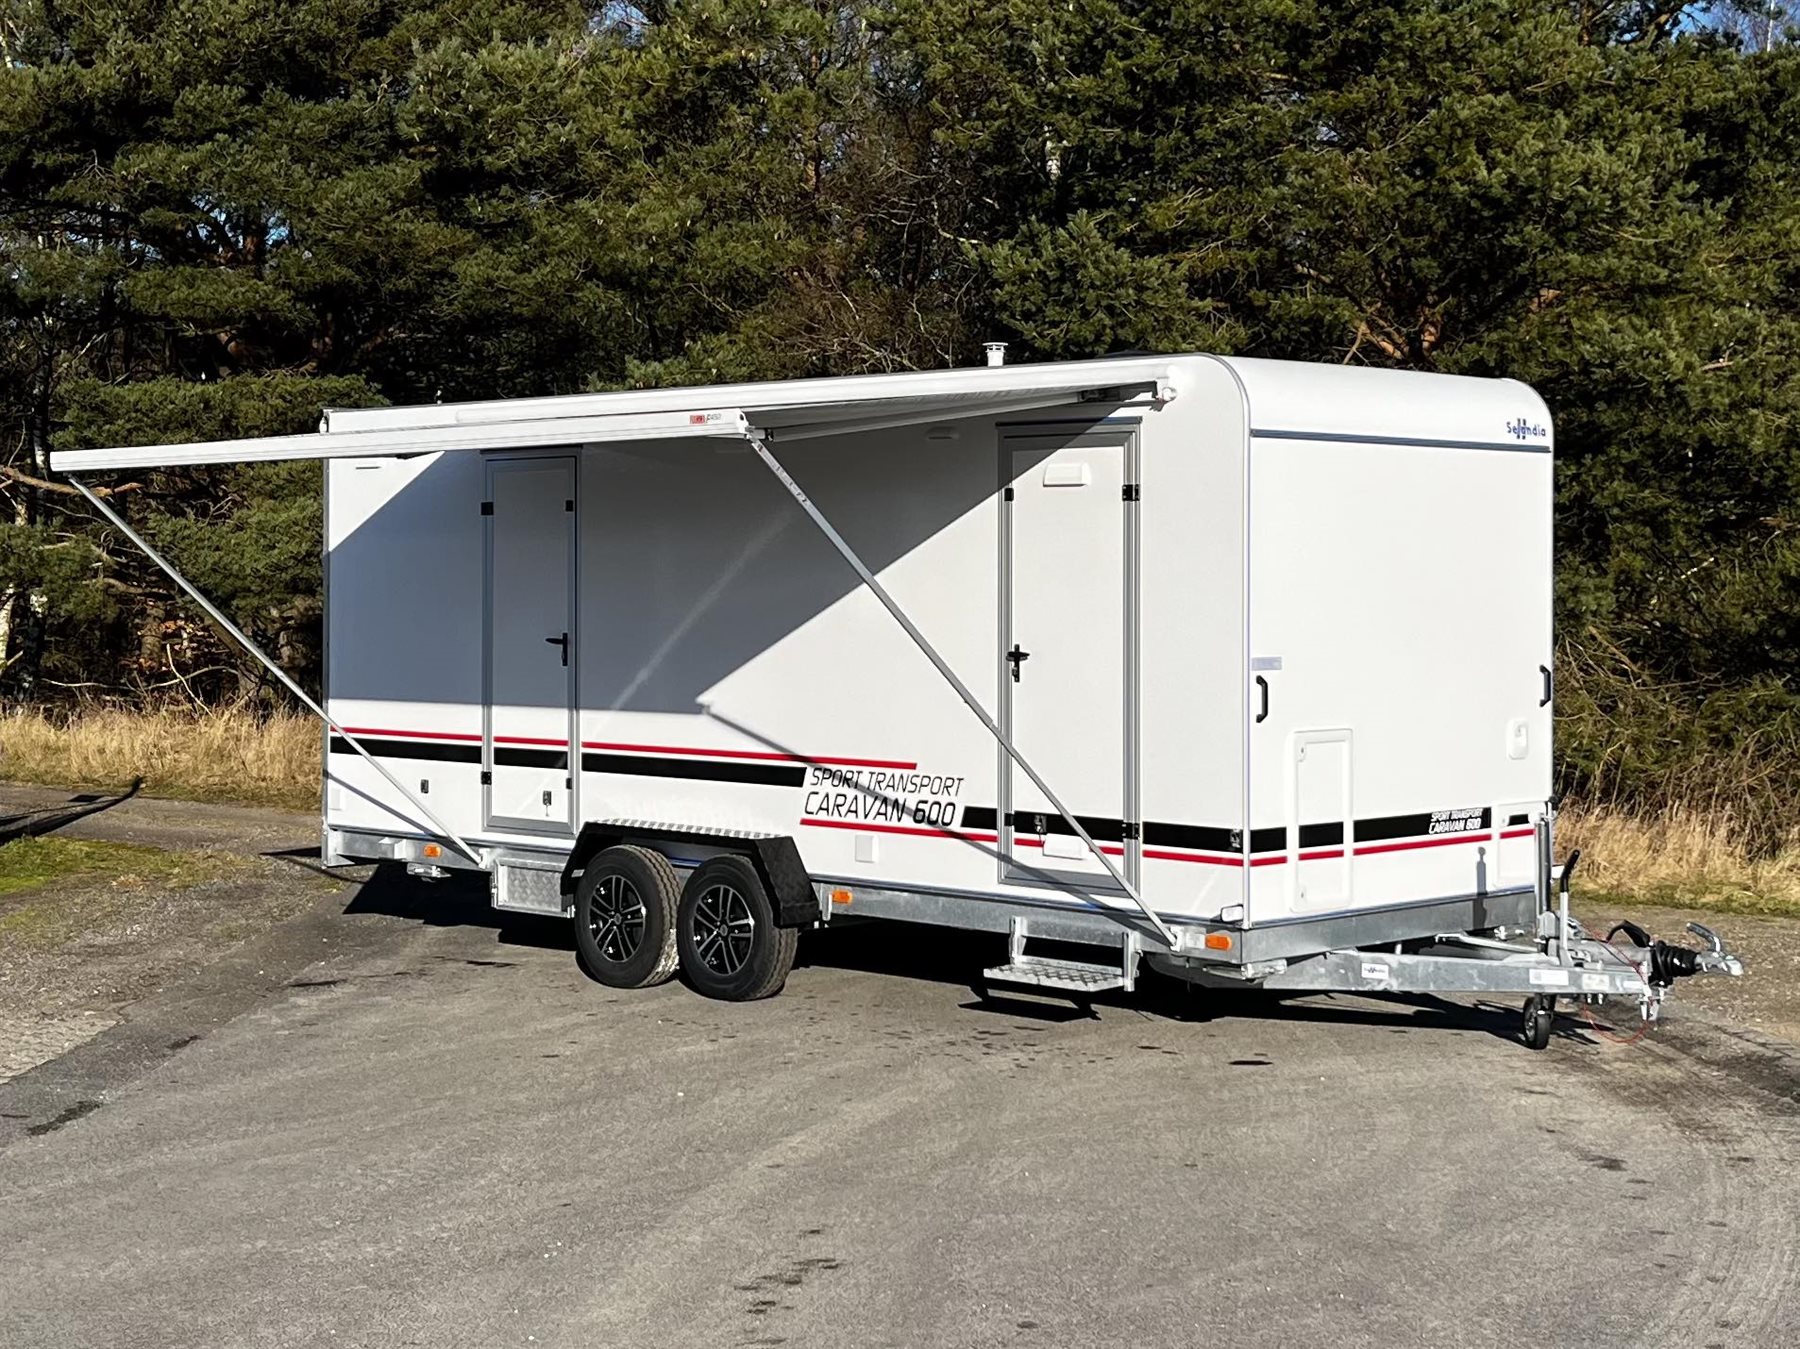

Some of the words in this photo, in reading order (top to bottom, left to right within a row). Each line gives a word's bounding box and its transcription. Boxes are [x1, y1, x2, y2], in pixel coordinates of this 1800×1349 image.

[810, 767, 863, 789] SPORT
[867, 771, 964, 797] TRANSPORT
[804, 791, 906, 822] CARAVAN
[912, 800, 956, 827] 600
[1428, 820, 1465, 835] CARAVAN
